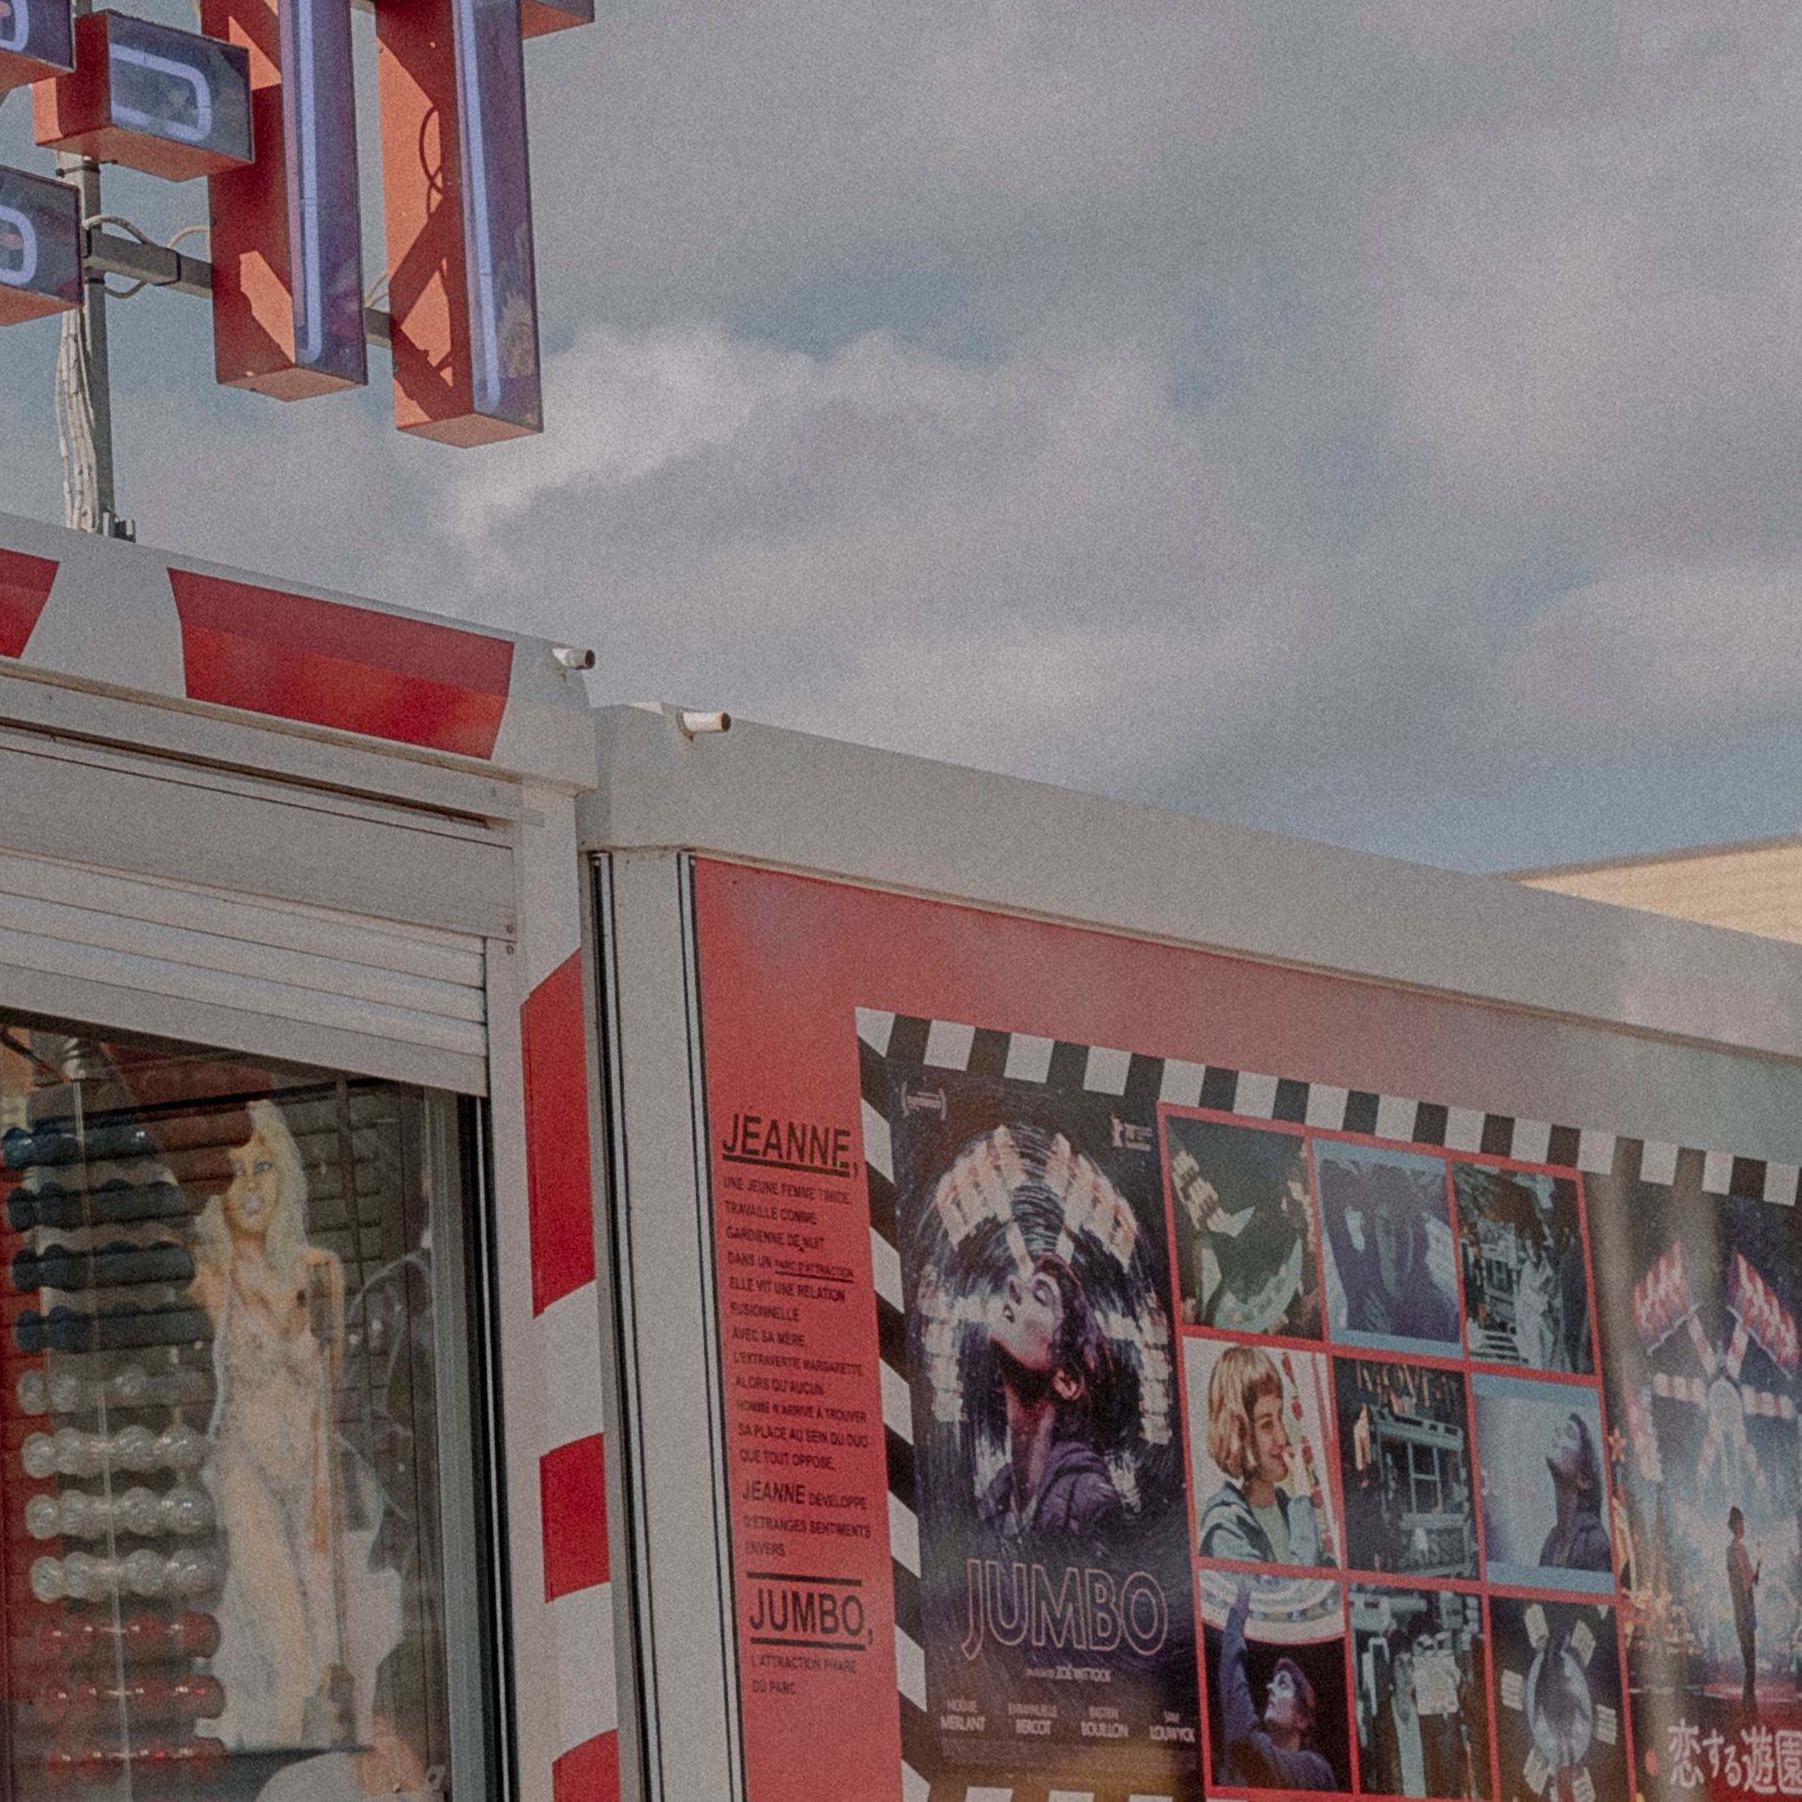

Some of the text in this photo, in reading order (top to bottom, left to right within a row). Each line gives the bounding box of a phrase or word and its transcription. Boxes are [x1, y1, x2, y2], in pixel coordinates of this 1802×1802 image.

[724, 1176, 743, 1190] UNE
[747, 1180, 779, 1196] JEUNE
[782, 1183, 815, 1200] FEMME
[725, 1200, 817, 1225] TRAVAILLE COMME
[726, 1225, 825, 1250] GARDIENNE DE NUIT
[727, 1251, 755, 1267] DANS
[758, 1255, 772, 1268] UN
[729, 1276, 845, 1302] ELLE VIT UNE RELATION
[730, 1301, 799, 1322] FUSIONNELLE
[732, 1327, 758, 1343] AVEC
[762, 1330, 775, 1343] SA
[735, 1376, 770, 1391] ALORS
[737, 1400, 770, 1414] HOMME
[826, 1408, 867, 1423] TROUVER
[738, 1423, 869, 1448] SA PLACE AU SEIN DU DUO
[740, 1450, 761, 1463] QUE
[763, 1451, 790, 1467] TOUT
[742, 1479, 805, 1505] JEANNE
[810, 1520, 871, 1539] SENTIMENTS
[745, 1541, 786, 1558] ENVERS
[749, 1587, 874, 1646] JUMBO,
[961, 1558, 1168, 1661] JUMBO
[824, 1658, 858, 1675] PHARE
[752, 1681, 767, 1694] DU
[940, 1715, 986, 1731] MERLANT
[1081, 1721, 1129, 1738] BOUILLON
